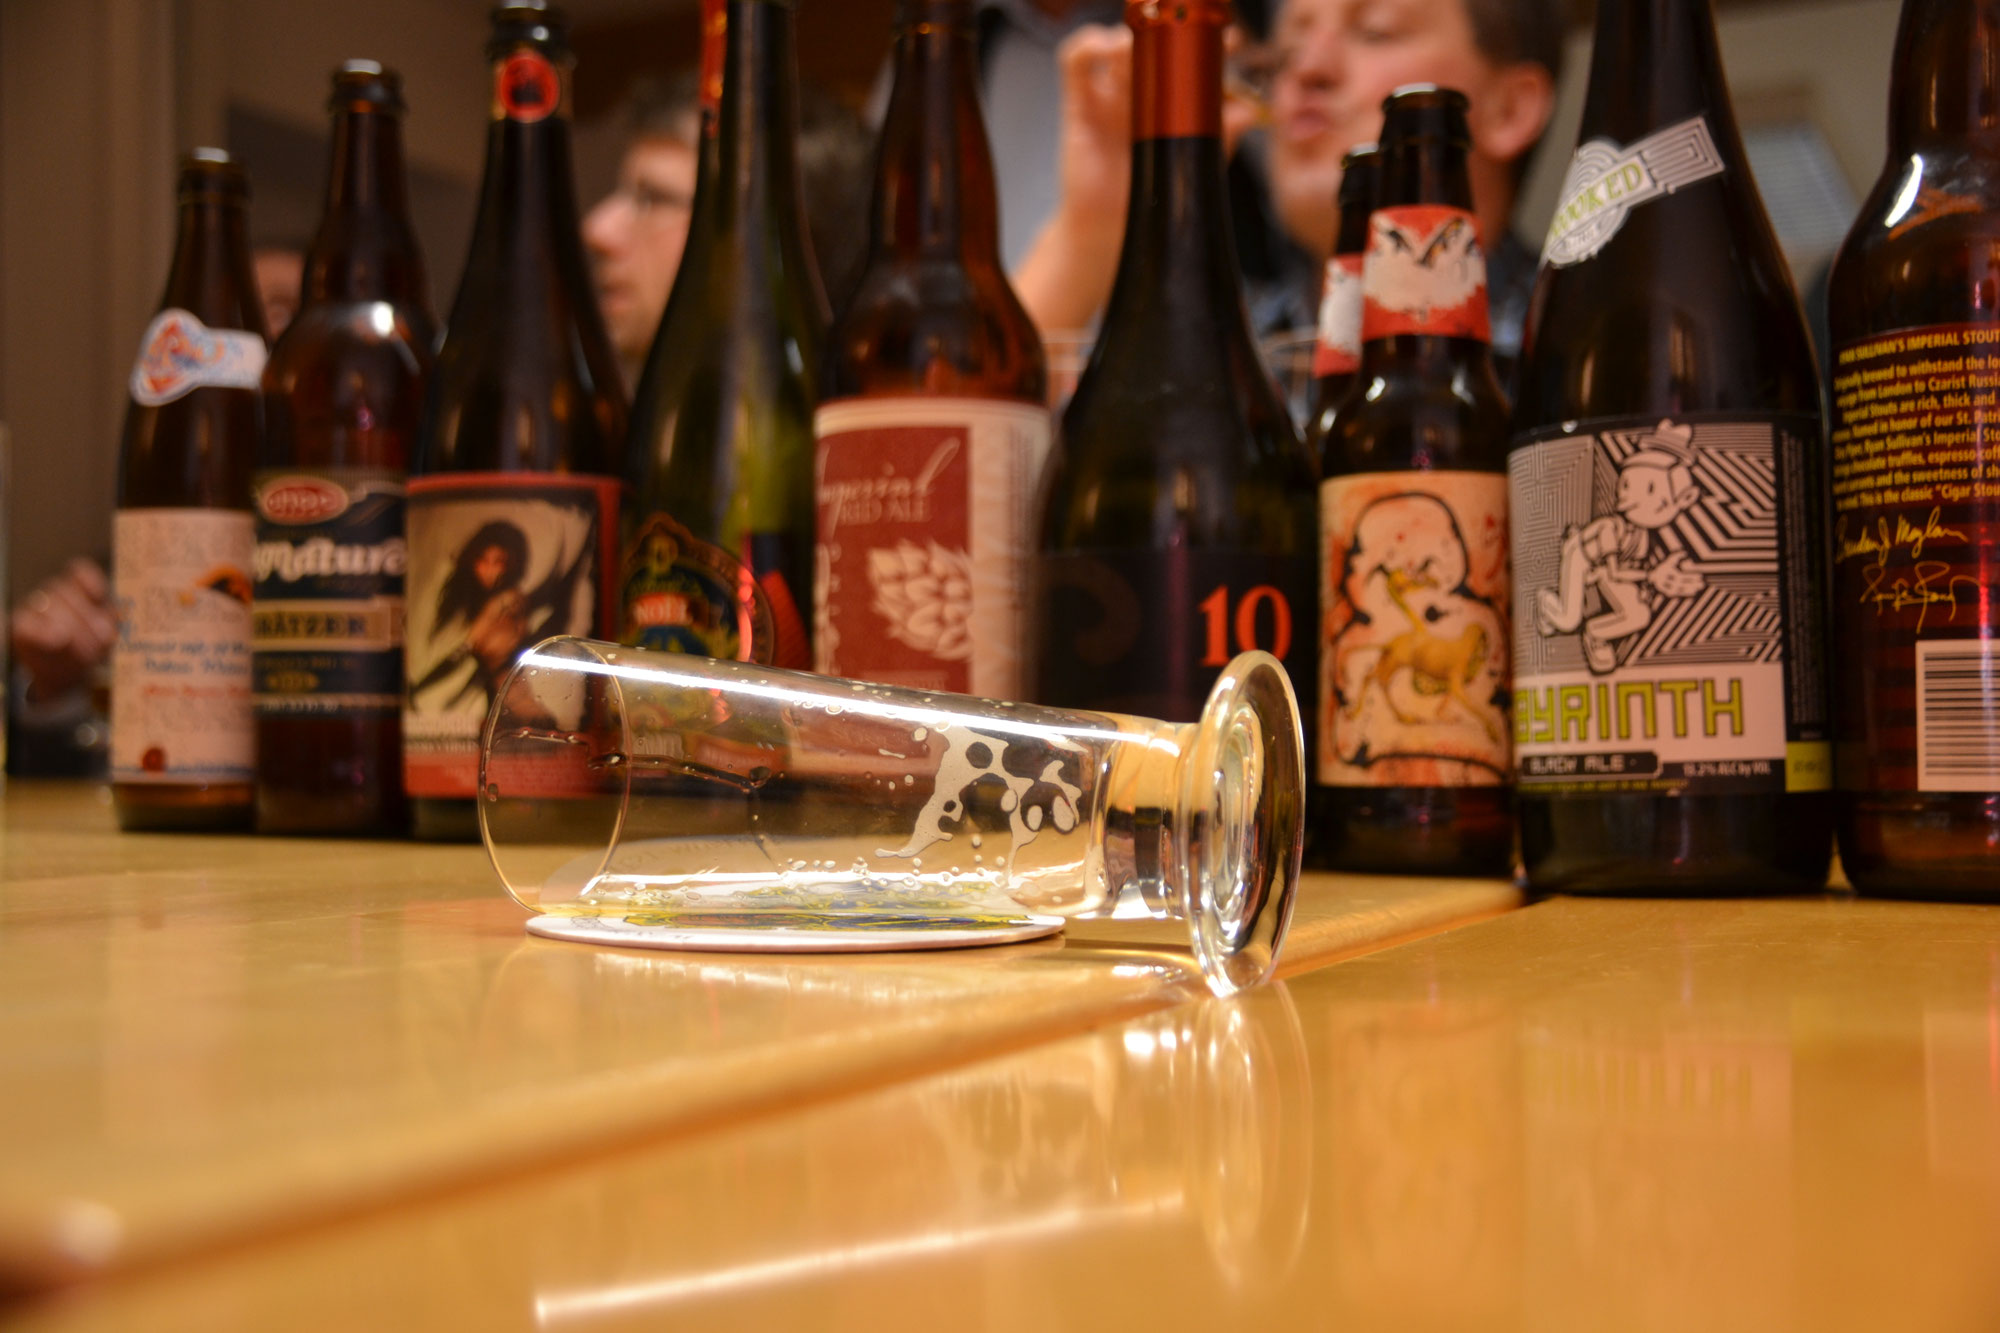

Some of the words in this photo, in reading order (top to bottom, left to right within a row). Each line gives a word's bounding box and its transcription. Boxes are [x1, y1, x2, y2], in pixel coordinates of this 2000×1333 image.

[1907, 331, 1959, 351] IMPERIAL
[1963, 327, 2000, 345] STOUT
[1896, 365, 1907, 378] to
[1909, 357, 1963, 376] withstand
[1966, 355, 1985, 371] the
[1878, 380, 1912, 399] London
[1914, 379, 1926, 394] to
[1928, 375, 1965, 392] Czarist
[1899, 400, 1915, 413] are
[1917, 394, 1941, 411] rich,
[1943, 391, 1970, 408] thick
[1973, 389, 1995, 406] and
[1889, 416, 1918, 432] honor
[1920, 411, 1932, 428] of
[1934, 413, 1954, 427] our
[1956, 411, 1972, 425] St.
[1886, 432, 1931, 451] Sullivan's
[1933, 427, 1981, 447] Imperial
[1928, 447, 1977, 466] espresso
[1876, 470, 1893, 487] and
[1894, 468, 1911, 485] the
[1912, 466, 1969, 483] sweetness
[1971, 463, 1984, 479] of
[1884, 487, 1899, 504] the
[1901, 484, 1934, 502] classic
[1935, 483, 1972, 502] "Cigar
[1198, 583, 1292, 667] 10
